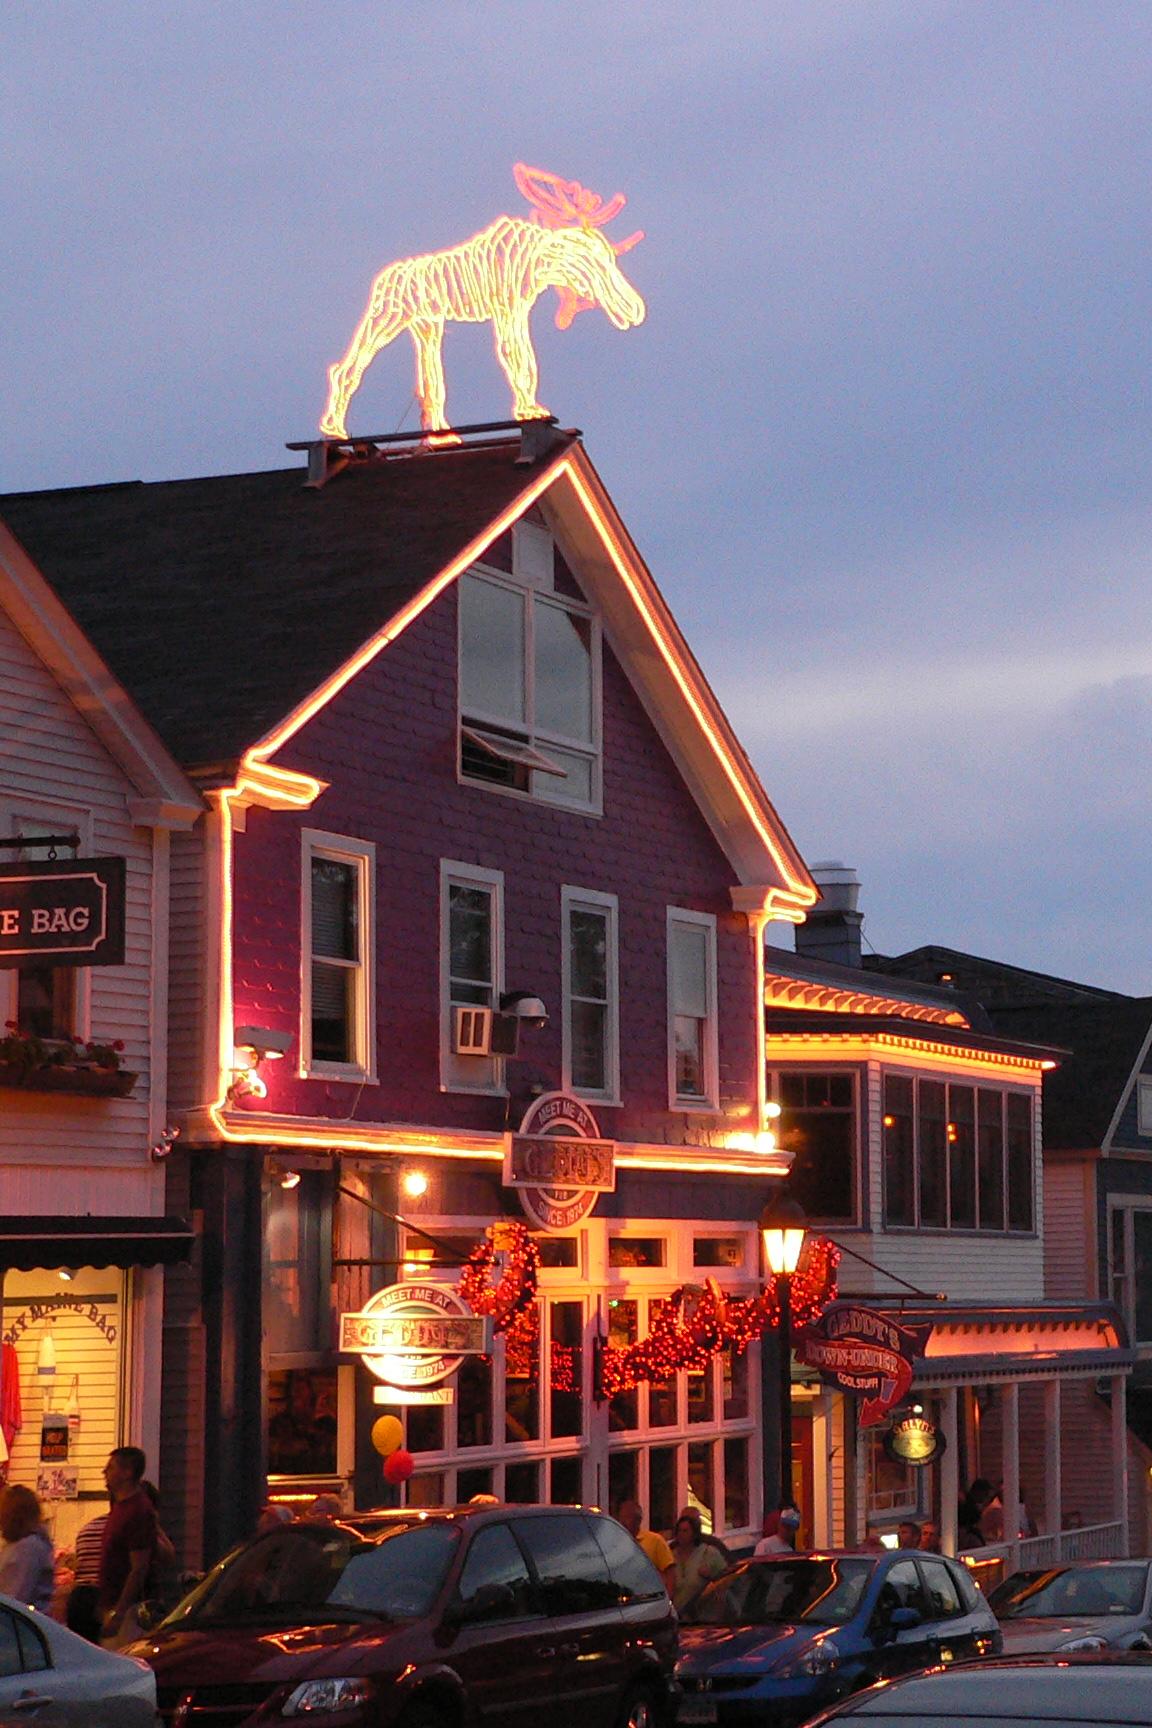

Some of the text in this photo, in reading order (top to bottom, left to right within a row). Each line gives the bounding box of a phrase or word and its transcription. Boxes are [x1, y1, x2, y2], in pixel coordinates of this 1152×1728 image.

[31, 906, 91, 934] BAG
[538, 1101, 588, 1126] MEET ME AT
[538, 1201, 584, 1225] SINCE 1974
[381, 1288, 451, 1308] MEET ME AT
[4, 1312, 28, 1345] MY
[88, 1303, 117, 1345] BAG
[837, 1372, 856, 1388] COOL
